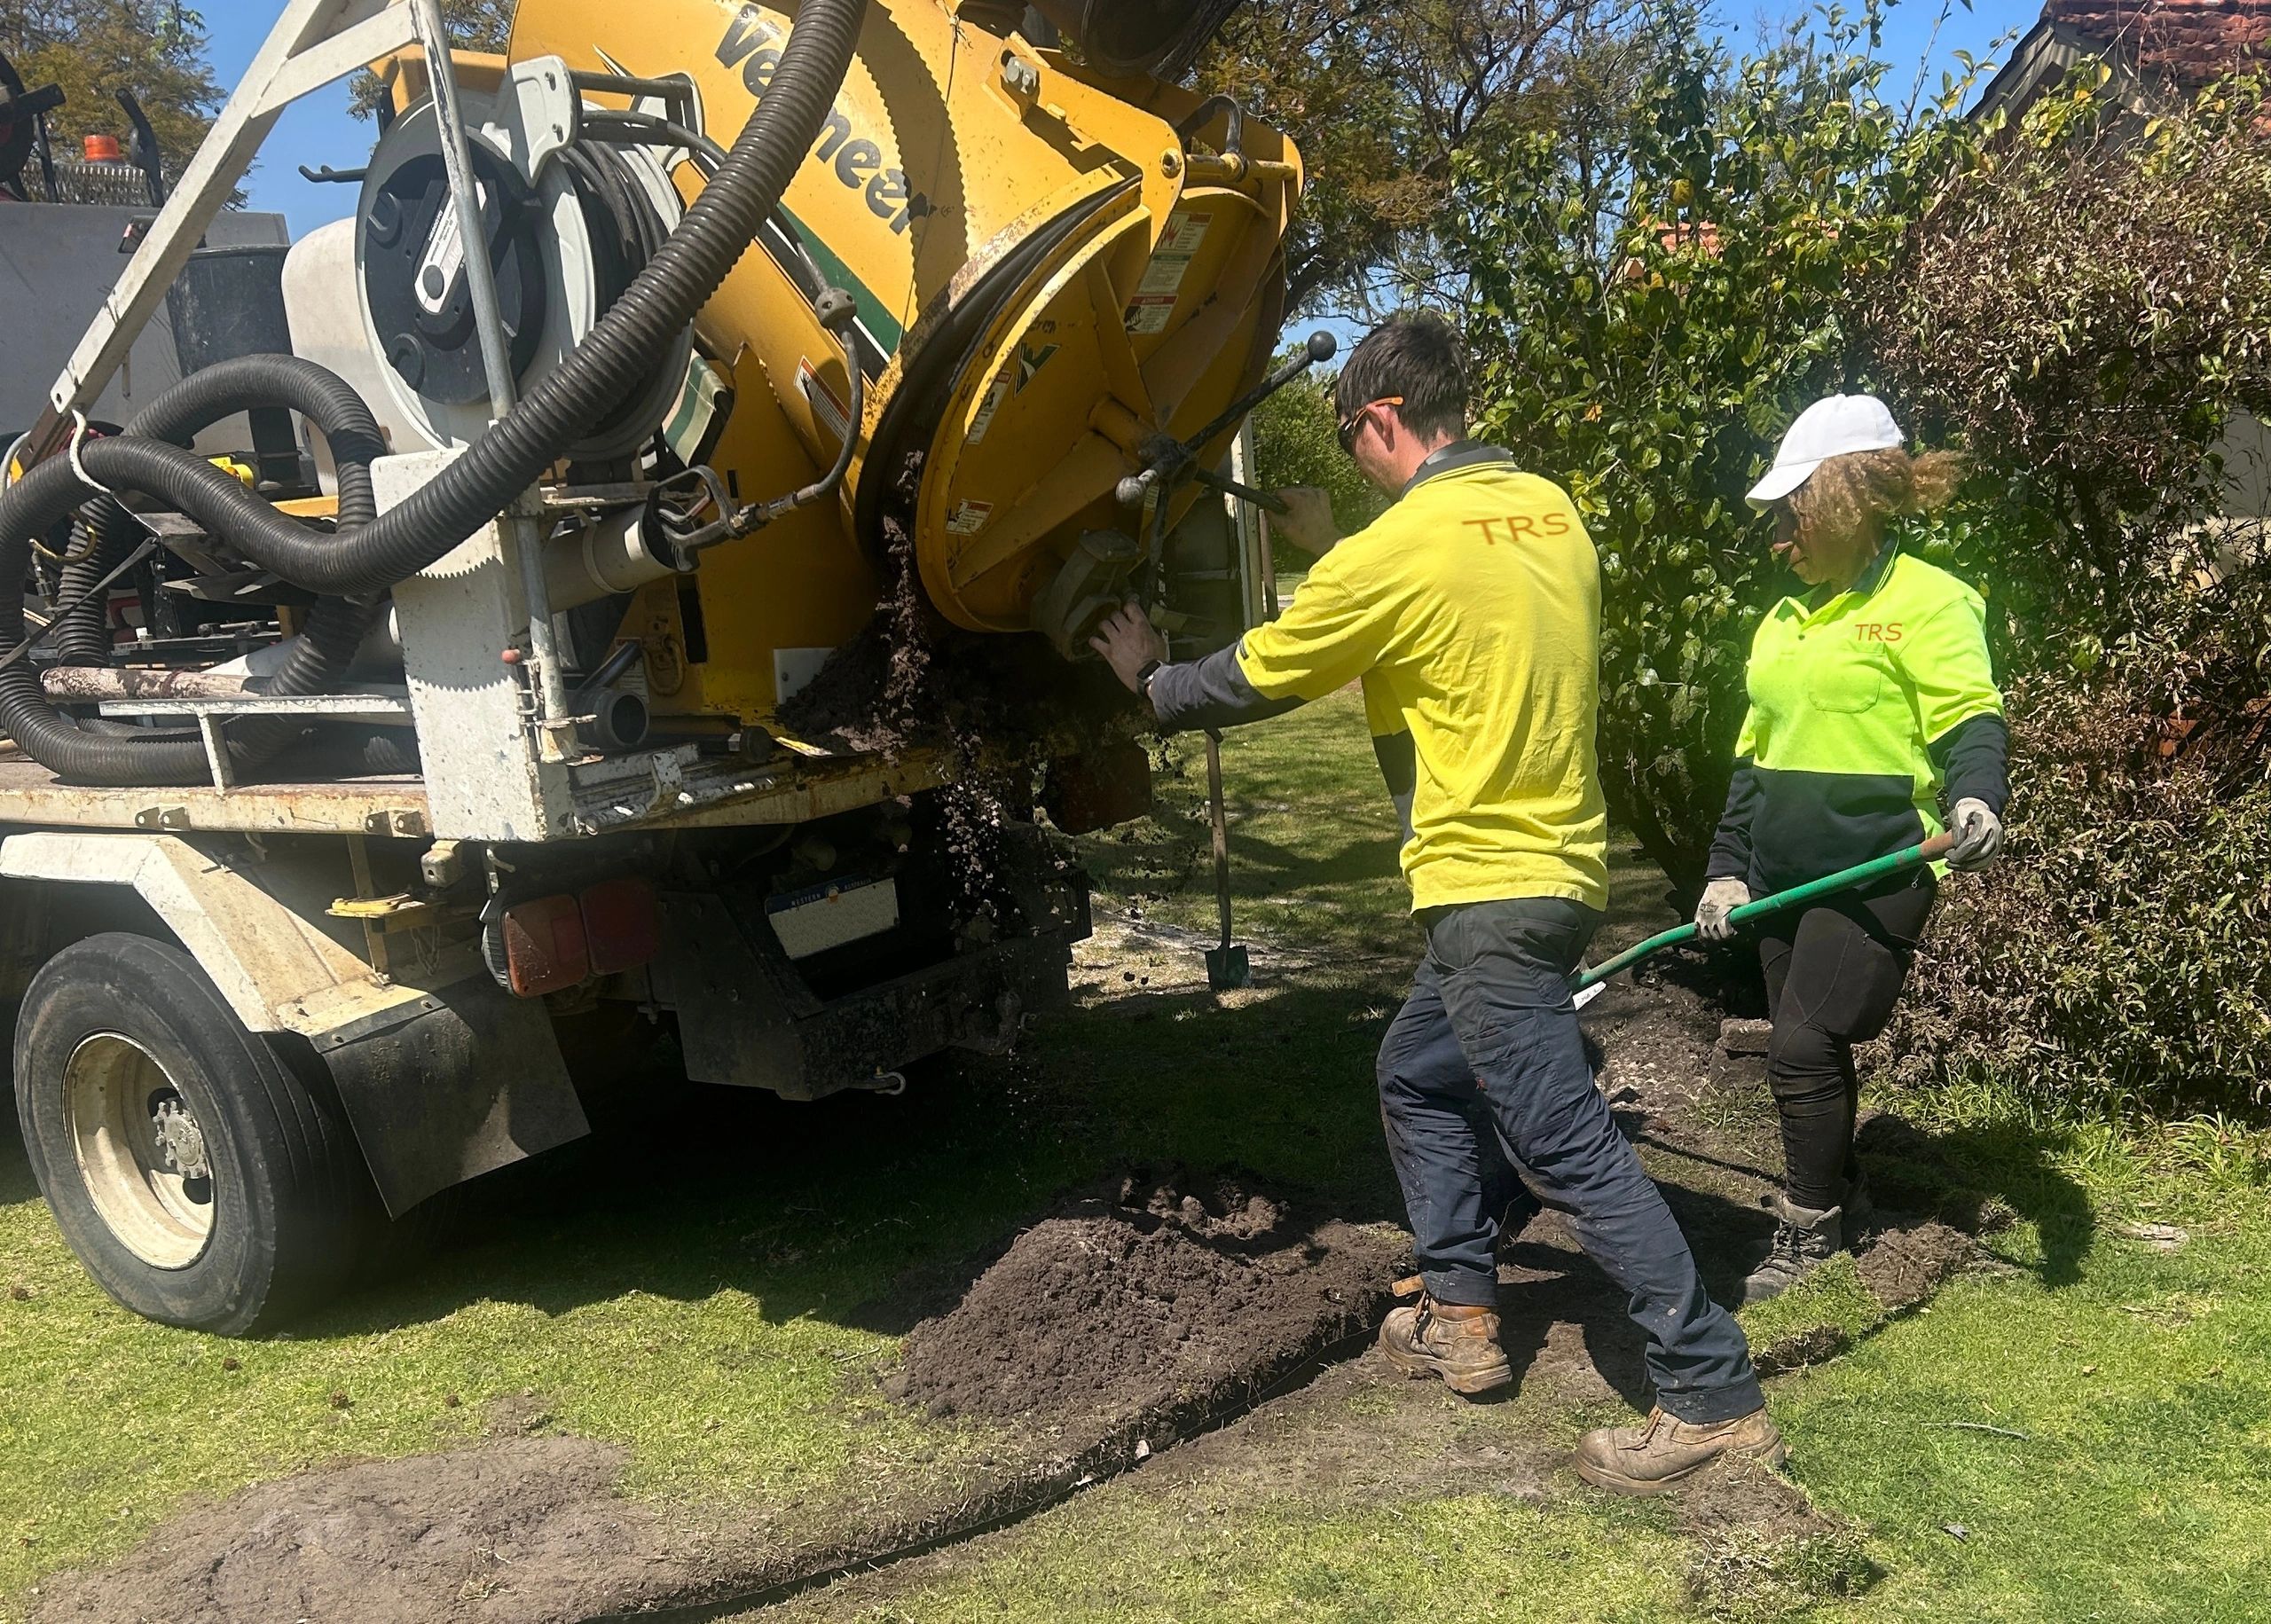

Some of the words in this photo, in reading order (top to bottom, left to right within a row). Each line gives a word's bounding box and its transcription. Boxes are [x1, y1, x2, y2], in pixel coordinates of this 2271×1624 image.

[715, 3, 938, 236] Veeer
[1461, 513, 1570, 545] TRS
[1854, 623, 1903, 641] TRS
